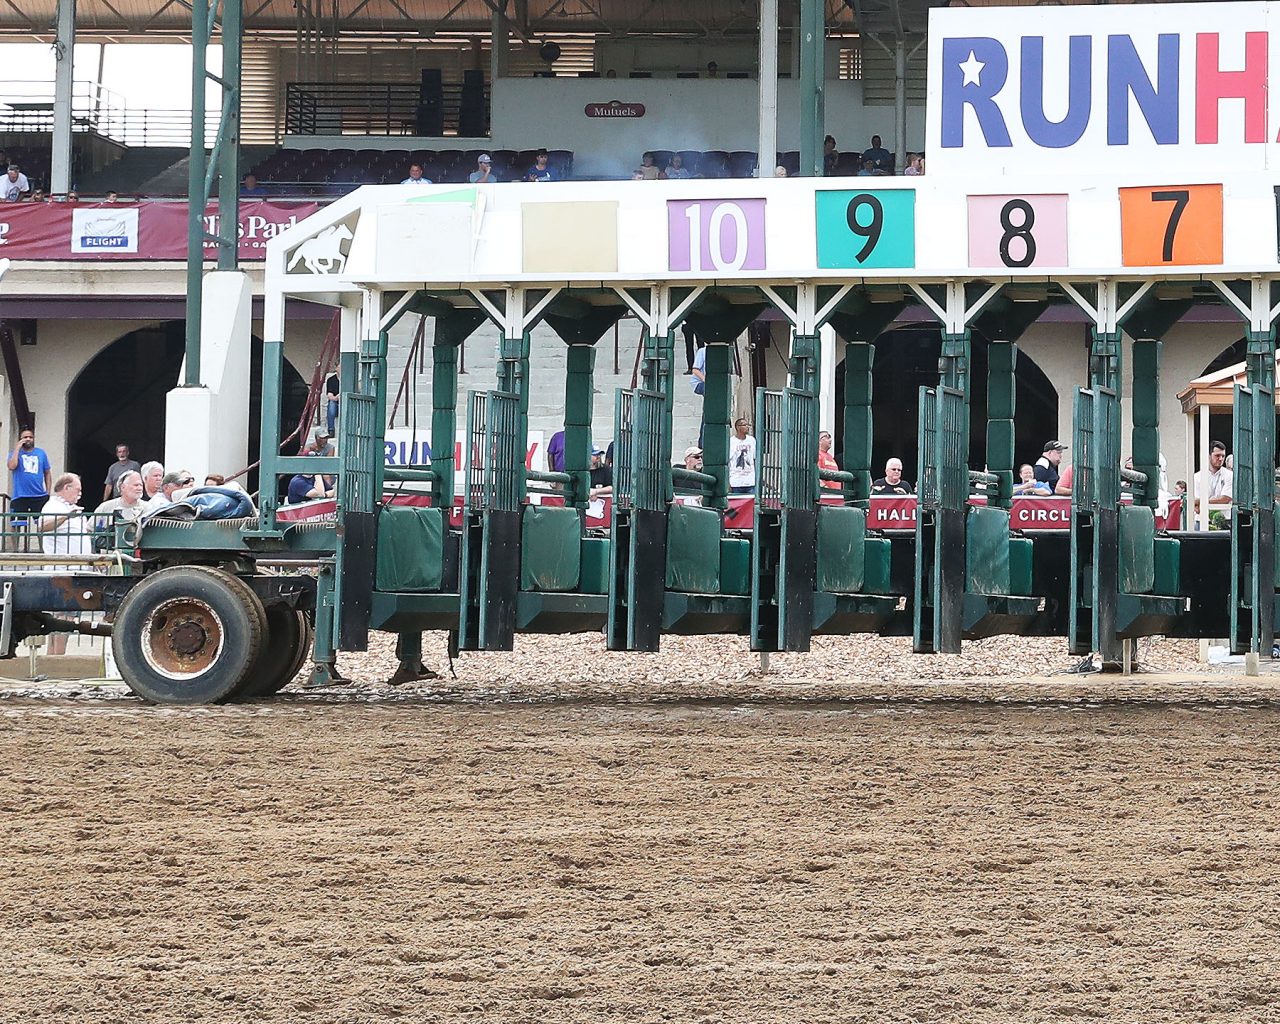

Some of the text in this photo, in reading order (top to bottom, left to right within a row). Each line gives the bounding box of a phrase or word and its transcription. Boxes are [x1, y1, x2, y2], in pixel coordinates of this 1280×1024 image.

[593, 107, 637, 116] Mutuels
[86, 237, 123, 246] FLIGHT
[685, 202, 748, 271] 10
[846, 194, 884, 264] 9
[1000, 199, 1037, 268] 8
[1151, 191, 1190, 262] 7
[1019, 509, 1071, 521] CIRCL
